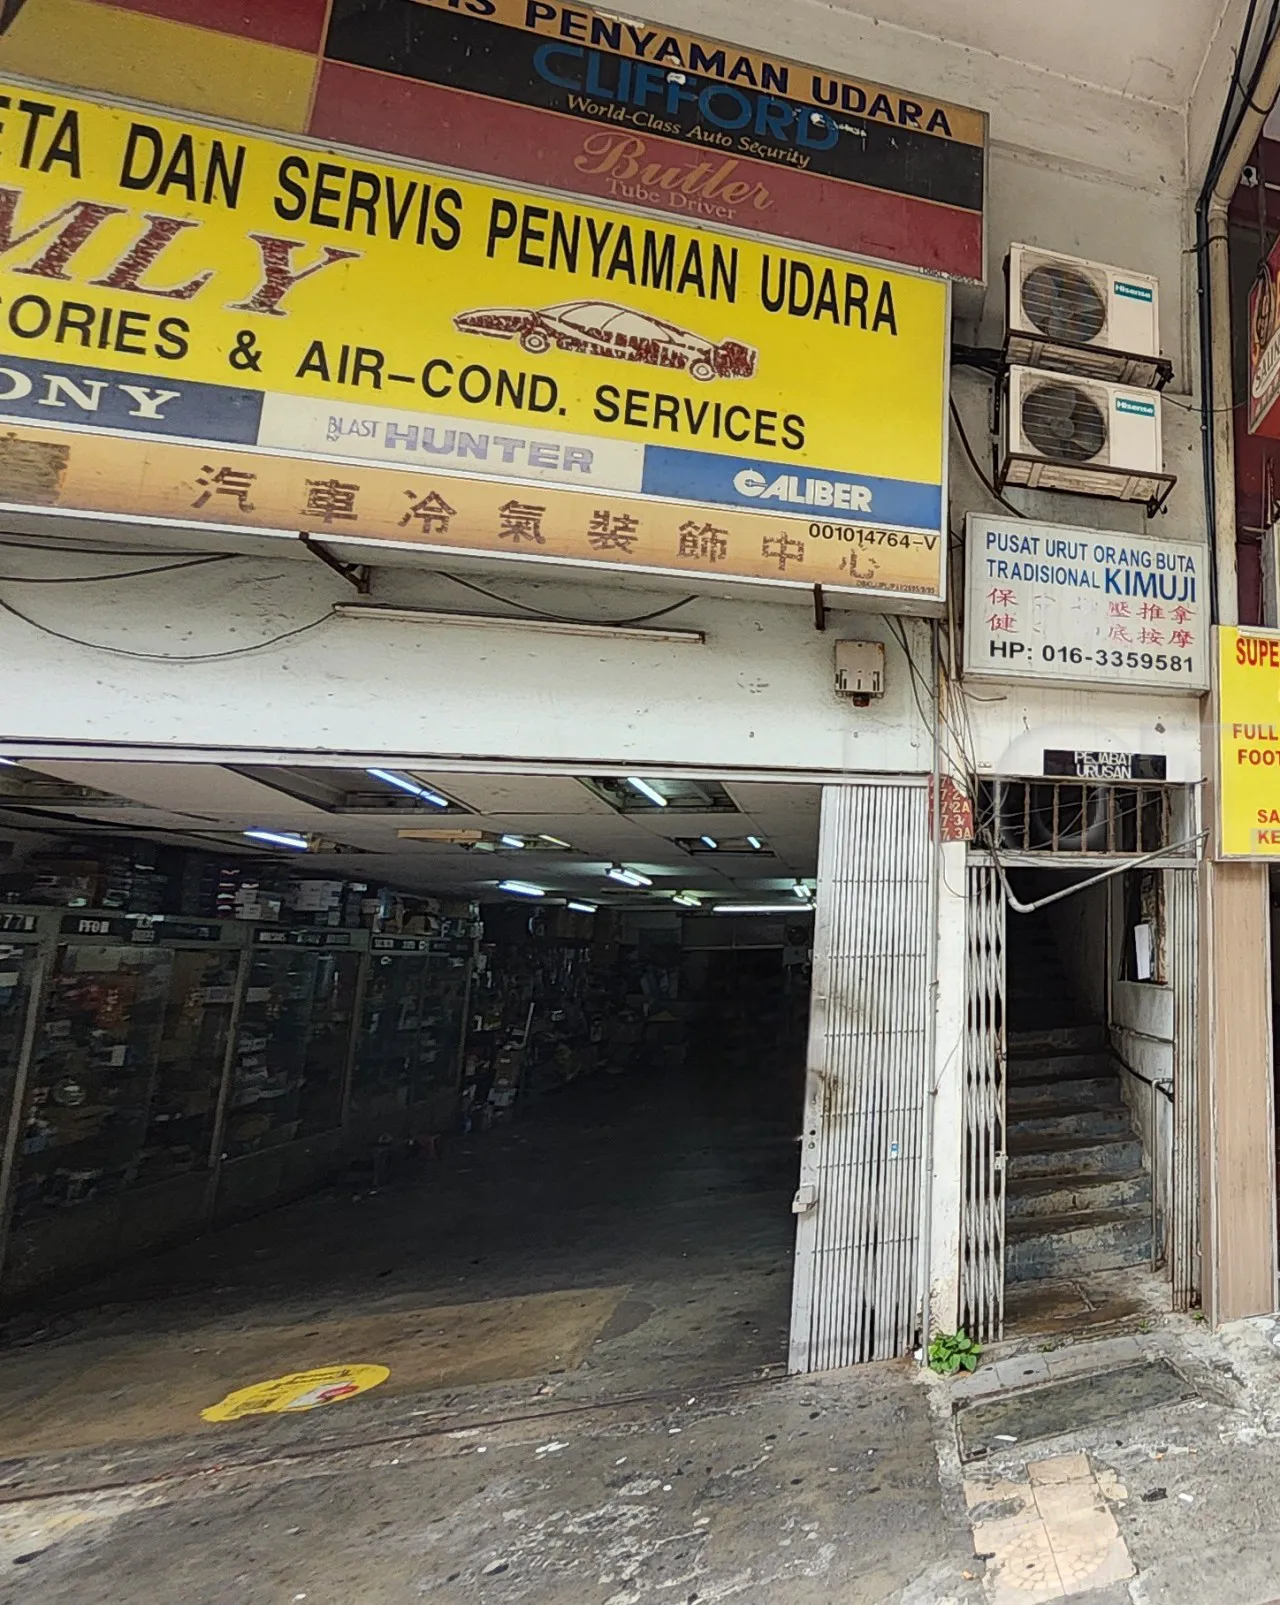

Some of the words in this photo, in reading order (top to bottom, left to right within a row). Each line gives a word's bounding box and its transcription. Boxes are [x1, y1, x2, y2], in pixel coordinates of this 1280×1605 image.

[526, 0, 789, 95] PENYAMAN
[812, 76, 953, 137] UDARA
[533, 43, 840, 151] CLIFFORD
[567, 94, 682, 135] World-Class
[687, 125, 733, 148] Auto
[738, 137, 812, 169] Security
[573, 131, 774, 211] Butler
[606, 177, 660, 203] Tube
[670, 196, 737, 221] Driver
[120, 123, 247, 209] DAN
[274, 156, 461, 250] SERVIS
[487, 199, 738, 304] PENYAMAN
[761, 255, 898, 336] UDARA
[1115, 284, 1151, 299] Hisense
[229, 331, 262, 373] &
[296, 340, 566, 416] AIR-COND.
[594, 385, 806, 450] SERVICES
[1116, 400, 1154, 414] Hisense
[327, 416, 380, 440] BLAST
[384, 422, 594, 474] HUNTER
[733, 467, 872, 513] CALIBER
[808, 523, 938, 552] 001014764-V
[986, 532, 1040, 555] PUSAT
[1046, 539, 1088, 561] URUT
[1094, 545, 1151, 568] ORANG
[1156, 553, 1195, 574] BUTA
[986, 558, 1100, 589] TRADISIONAL
[1105, 568, 1196, 603] KIMUJI
[989, 640, 1033, 661] HP:
[1042, 645, 1193, 673] 016-3359581
[1233, 723, 1278, 741] FULL
[1074, 751, 1135, 767] PEJABAT
[1076, 764, 1132, 779] URUSAN
